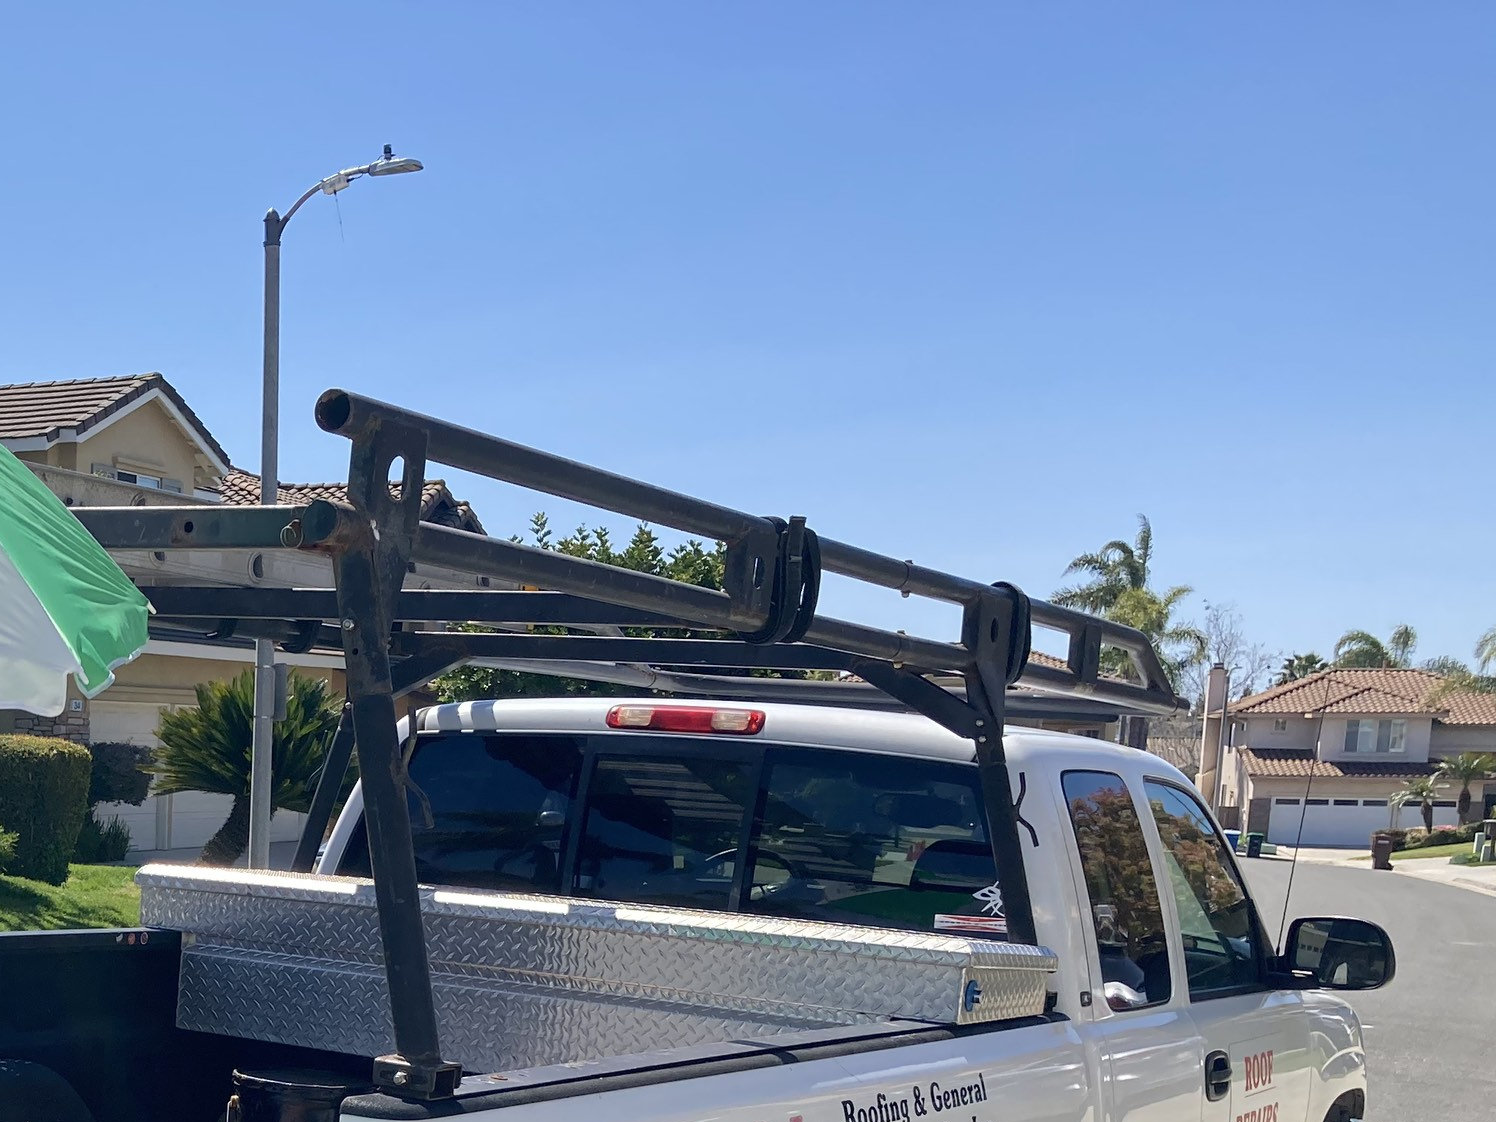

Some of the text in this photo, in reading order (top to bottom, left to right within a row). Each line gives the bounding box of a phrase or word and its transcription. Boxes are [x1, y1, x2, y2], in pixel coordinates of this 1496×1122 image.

[1244, 1049, 1274, 1092] ROOF
[913, 1085, 928, 1118] &
[929, 1072, 988, 1113] General
